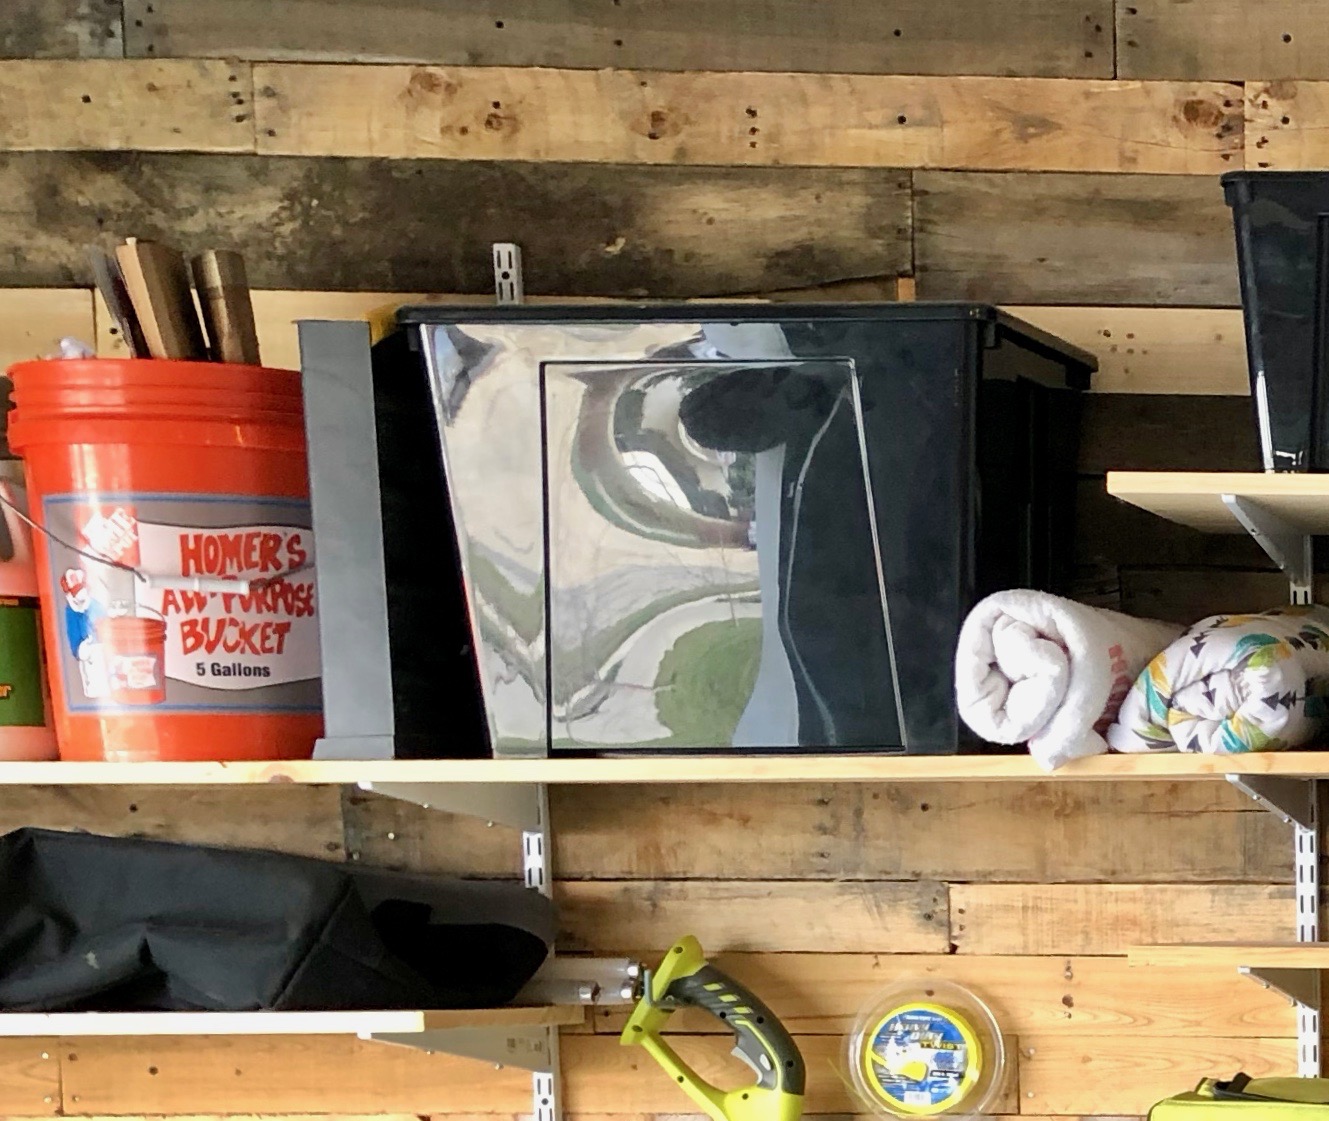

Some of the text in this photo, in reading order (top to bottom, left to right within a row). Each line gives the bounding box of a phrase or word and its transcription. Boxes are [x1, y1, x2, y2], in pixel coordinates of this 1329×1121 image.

[179, 531, 307, 577] HOMER'S
[180, 617, 291, 656] BUCKET
[196, 662, 272, 678] 5 Gallons
